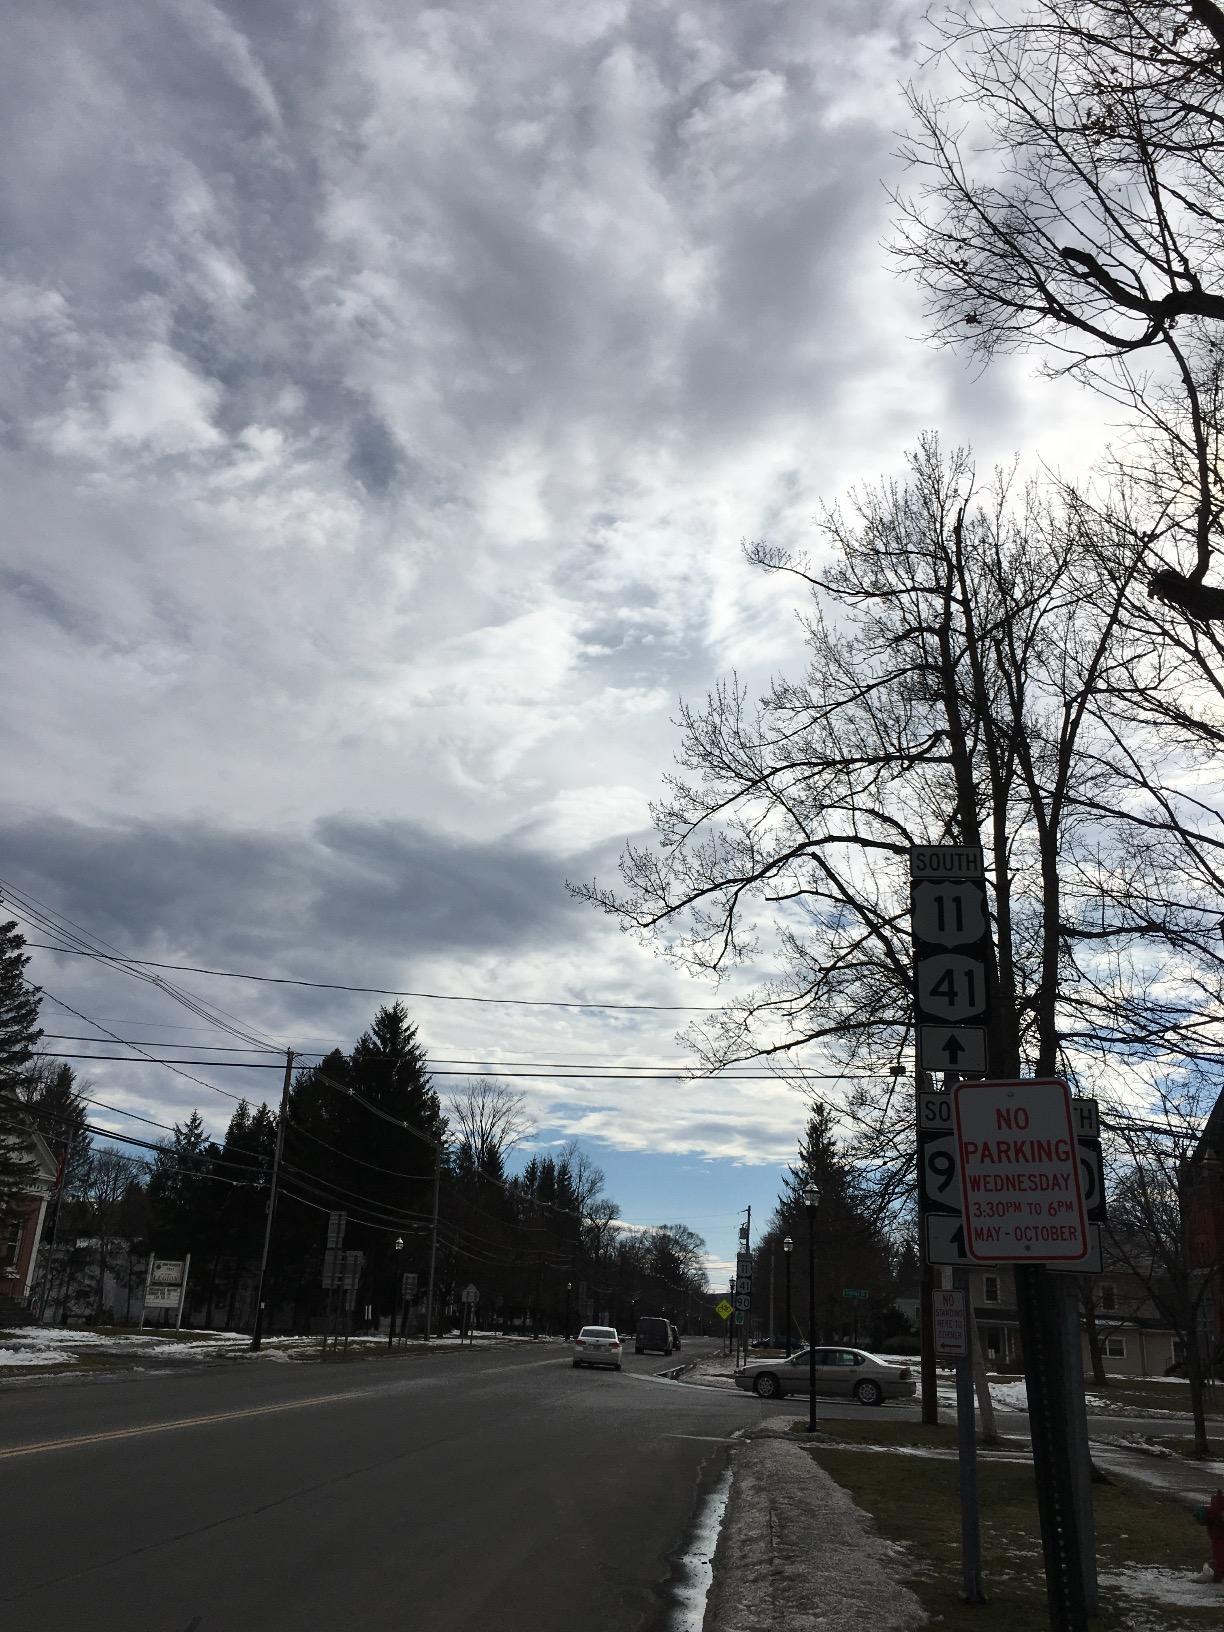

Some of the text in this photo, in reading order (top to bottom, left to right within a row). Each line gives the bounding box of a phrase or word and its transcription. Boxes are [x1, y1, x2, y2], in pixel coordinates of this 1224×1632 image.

[916, 853, 978, 872] SOUTH
[934, 895, 963, 932] 11
[929, 968, 976, 1007] 41
[995, 1107, 1029, 1130] NO
[963, 1139, 1071, 1164] PARKING
[928, 1150, 956, 1193] 9
[968, 1173, 1071, 1192] WEDNESDAY
[973, 1200, 1074, 1218] 3:30PM TO 6PM
[974, 1226, 1001, 1242] MAY
[1014, 1226, 1078, 1242] OCTOBER
[738, 1298, 749, 1308] 90
